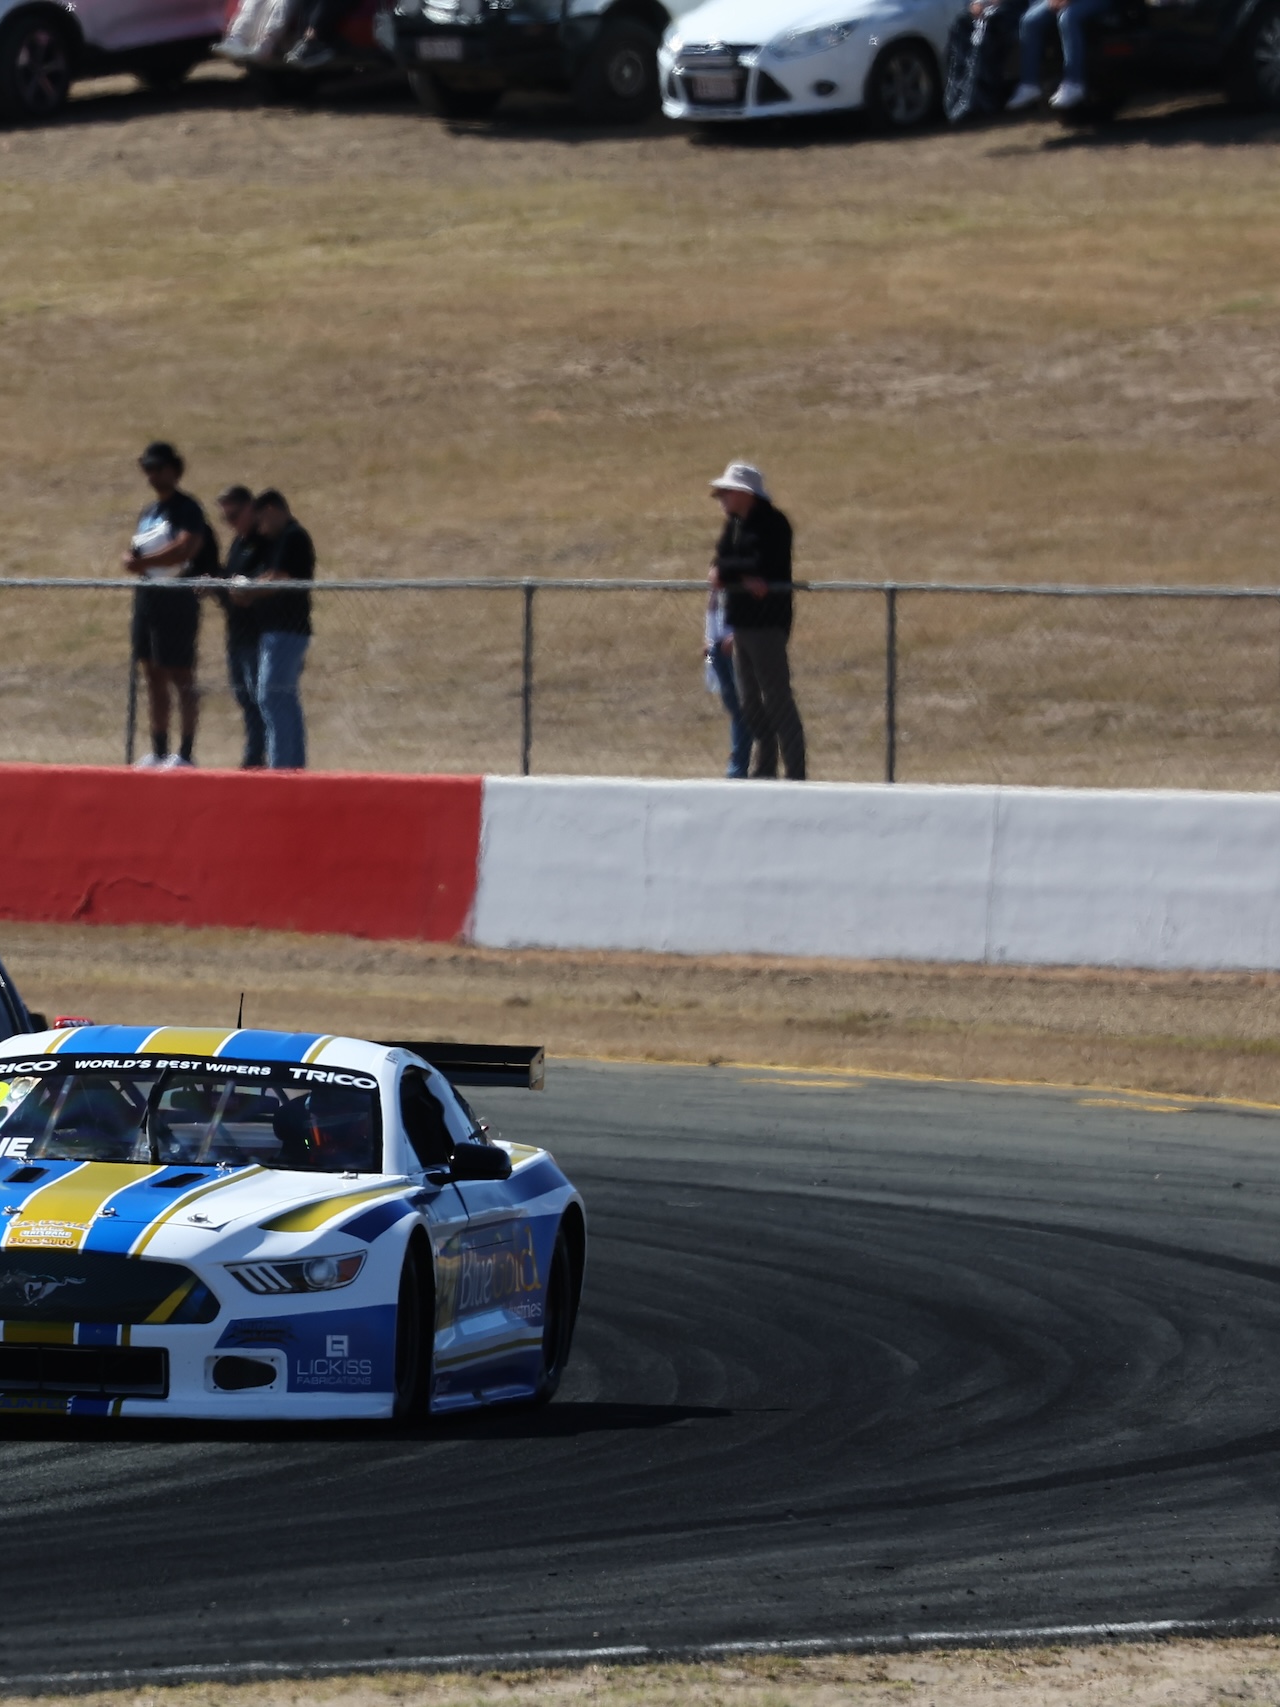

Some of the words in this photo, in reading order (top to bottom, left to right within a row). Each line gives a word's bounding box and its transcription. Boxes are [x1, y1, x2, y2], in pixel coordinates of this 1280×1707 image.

[74, 1059, 151, 1070] WORLD'S
[155, 1059, 202, 1071] BEST
[205, 1062, 272, 1076] WIPERS
[288, 1067, 378, 1090] TRICO
[296, 1359, 372, 1375] LICKISS
[296, 1376, 372, 1386] FABRICATIONS
